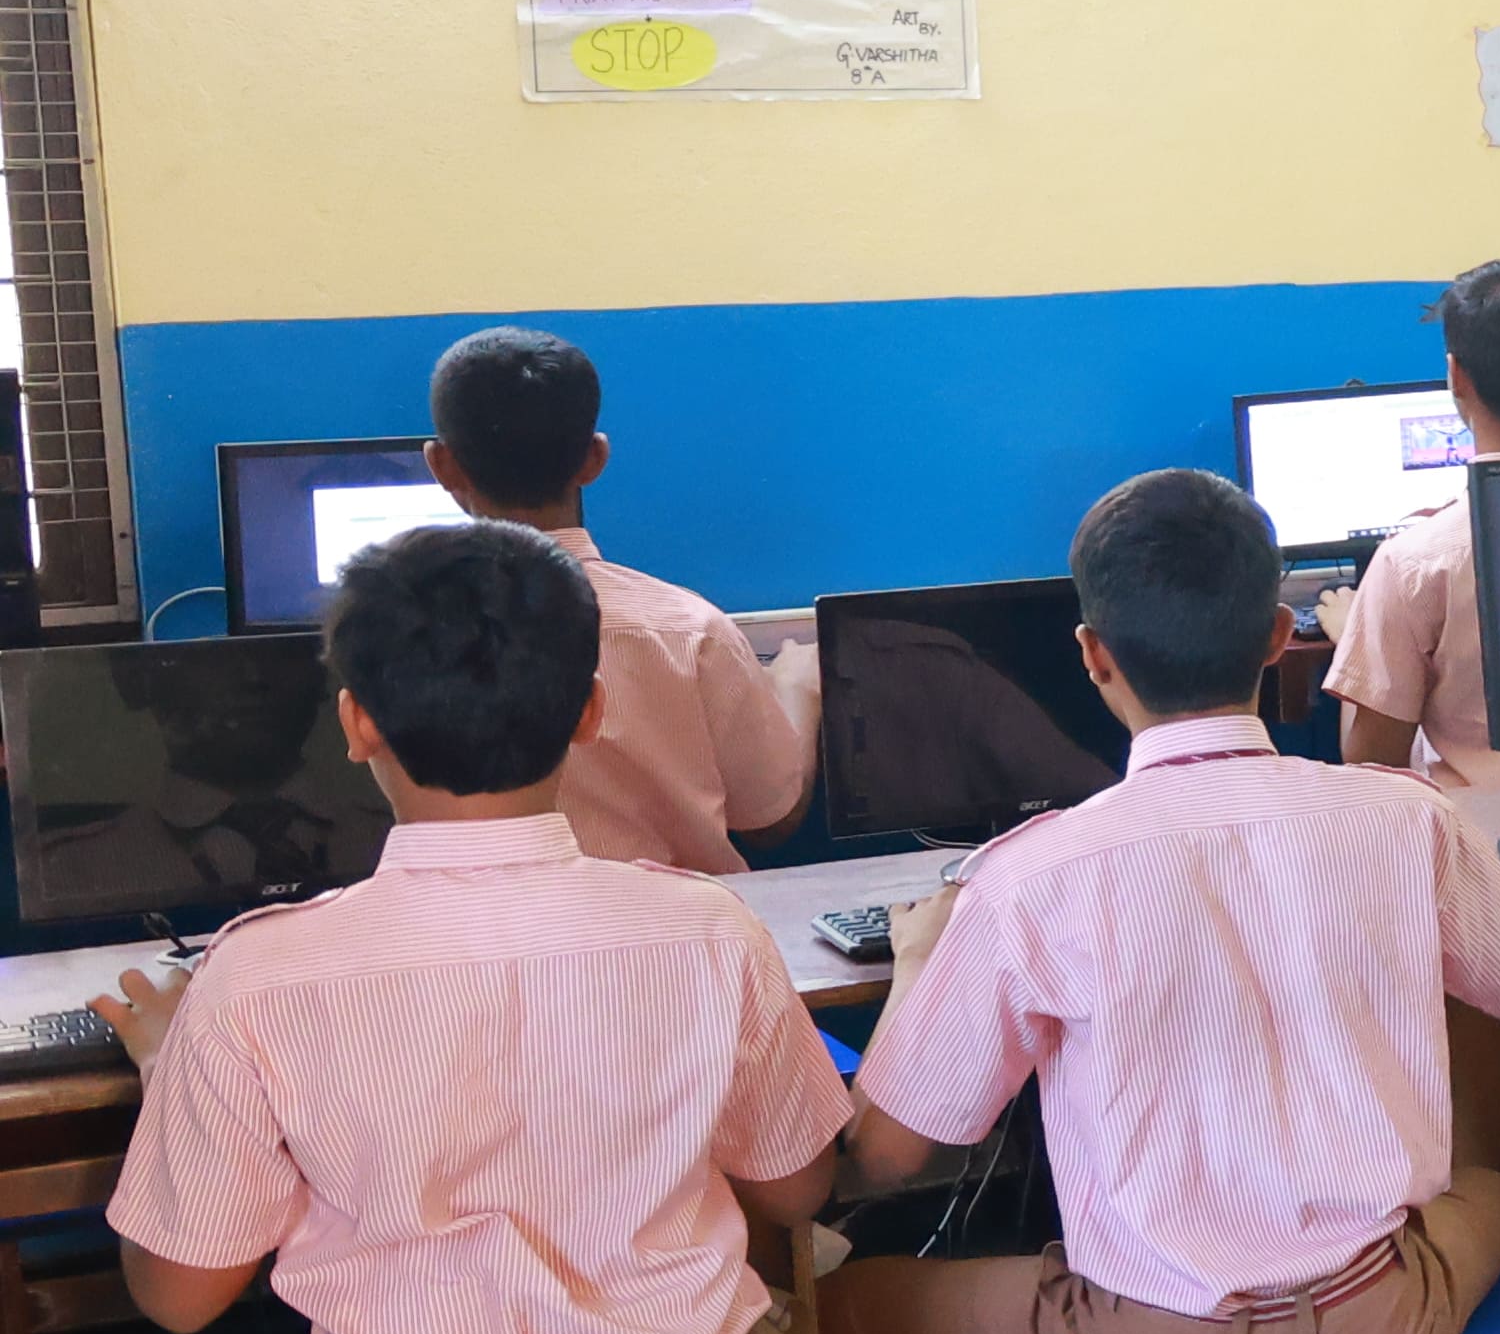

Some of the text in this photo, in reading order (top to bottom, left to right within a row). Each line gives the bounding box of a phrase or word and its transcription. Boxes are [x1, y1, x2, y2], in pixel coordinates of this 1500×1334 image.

[892, 9, 920, 26] ART
[589, 25, 686, 75] STOP
[1019, 798, 1053, 812] acer
[261, 882, 304, 896] acer
